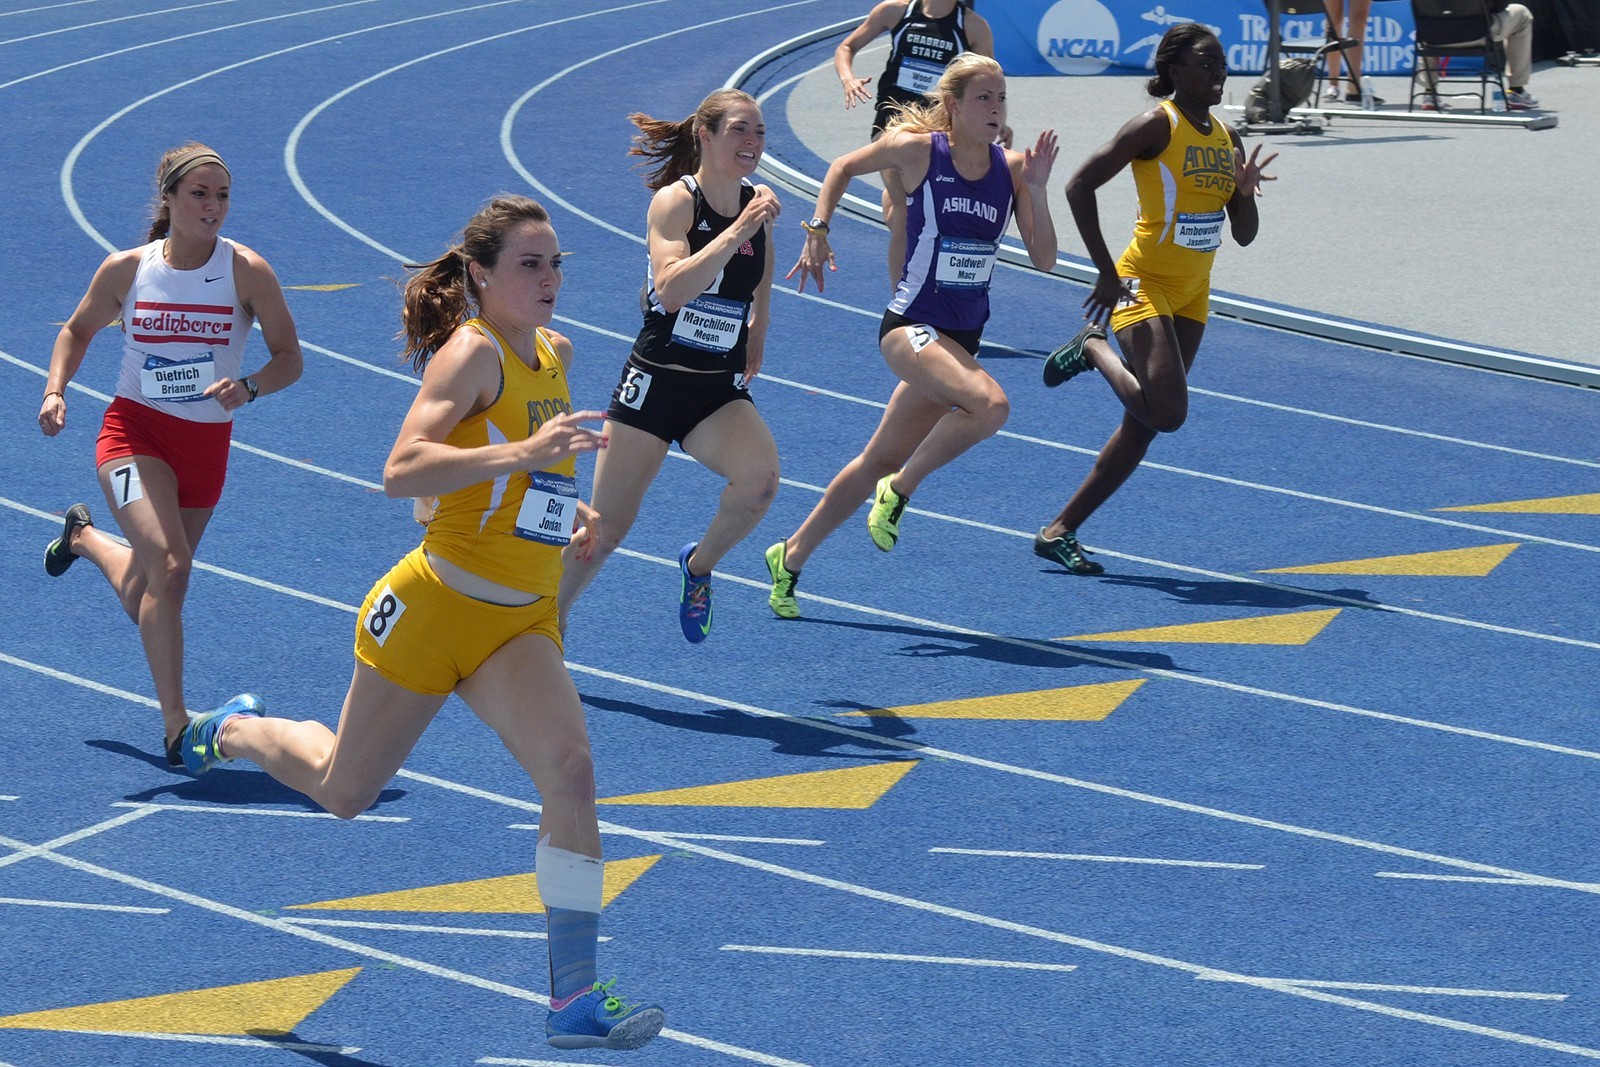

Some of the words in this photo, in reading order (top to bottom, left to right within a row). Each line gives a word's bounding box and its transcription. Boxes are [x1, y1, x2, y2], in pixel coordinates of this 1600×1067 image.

[1238, 14, 1313, 42] TRCK
[906, 33, 954, 51] CHADRON
[1048, 38, 1116, 61] NCAA
[911, 45, 944, 60] STATE
[1194, 174, 1235, 193] STATE
[941, 197, 998, 223] ASHLAND
[949, 256, 986, 268] Caldwell
[957, 270, 976, 281] Macy
[142, 312, 222, 334] edinboro
[683, 310, 736, 334] Marchildon
[693, 329, 720, 343] Megan
[155, 366, 200, 382] Dietrich
[161, 384, 196, 394] Brianne
[624, 372, 644, 404] 6
[115, 467, 131, 503] 7
[546, 498, 564, 517] Gray
[538, 516, 562, 533] Jordan
[370, 594, 397, 637] 8
